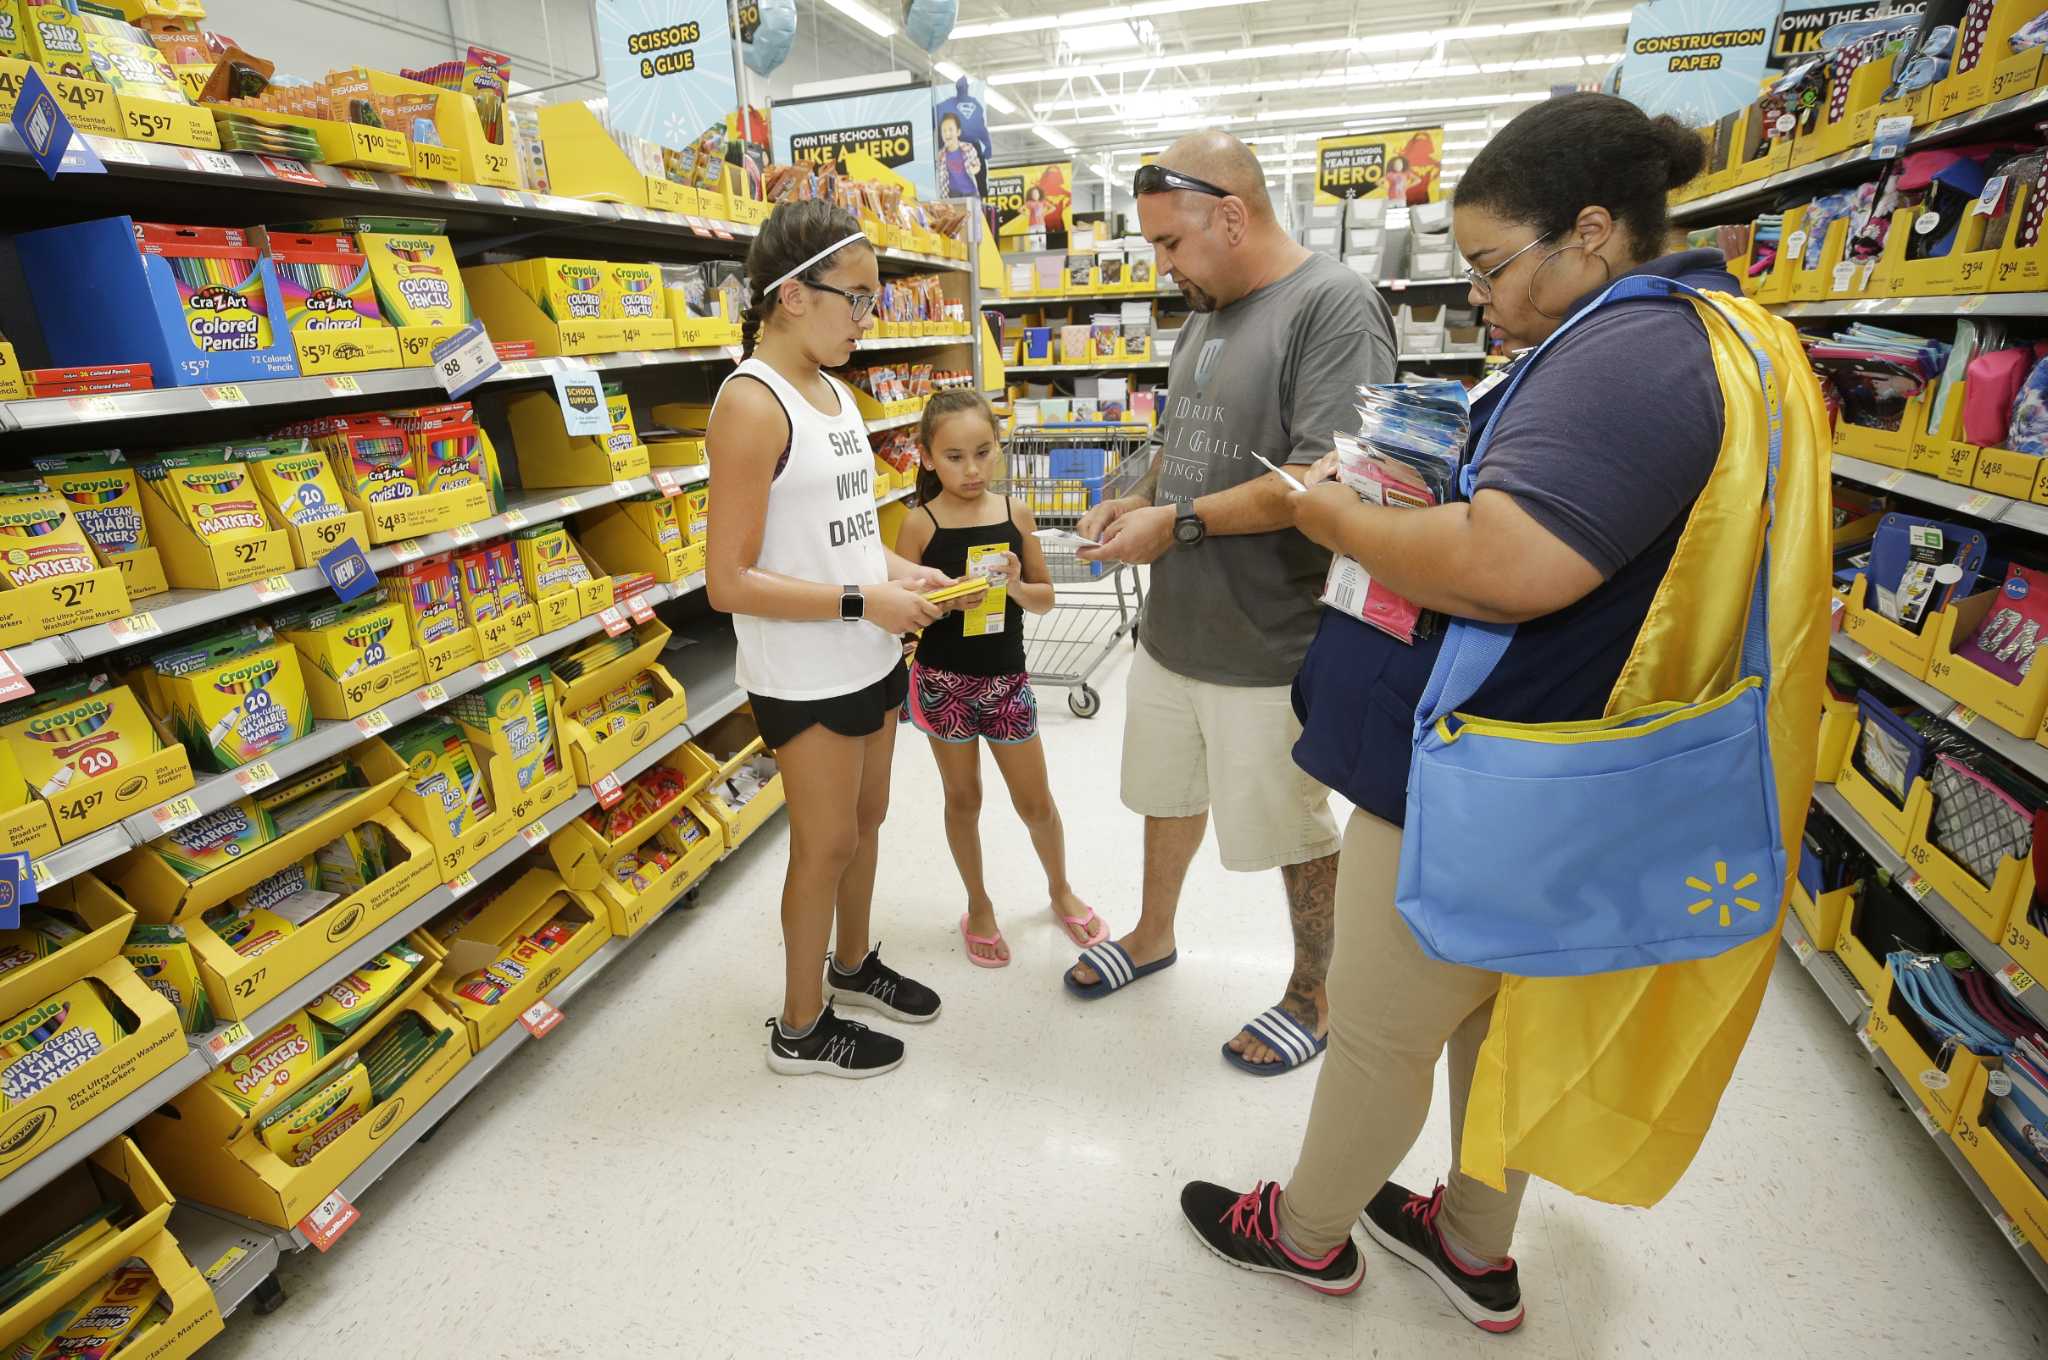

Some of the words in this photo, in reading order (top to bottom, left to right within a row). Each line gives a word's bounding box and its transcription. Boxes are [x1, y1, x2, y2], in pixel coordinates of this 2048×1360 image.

[1781, 12, 1825, 31] OWN
[1829, 9, 1861, 25] THE
[39, 22, 78, 41] Silly
[151, 34, 198, 42] FISKARS
[629, 22, 699, 53] SCISSORS
[1634, 29, 1764, 54] CONSTRUCTION
[1776, 31, 1824, 55] LIK
[109, 54, 154, 74] Silly
[641, 61, 653, 78] &
[656, 52, 693, 75] GLUE
[1669, 54, 1721, 73] PAPER
[331, 84, 368, 96] FISKARS
[398, 104, 433, 113] FISKARS
[794, 135, 818, 147] OWN
[819, 132, 838, 145] THE
[840, 129, 880, 142] SCHOOL
[882, 125, 909, 137] YEAR
[839, 145, 850, 161] A
[1355, 147, 1382, 156] SCHOOL
[1324, 157, 1350, 169] YEAR
[1352, 155, 1371, 166] LIKE
[1373, 154, 1382, 164] A
[1323, 164, 1382, 186] HERO
[359, 223, 371, 232] 50
[389, 239, 431, 250] Crayola
[562, 265, 597, 278] Crayola
[616, 268, 649, 280] Crayola
[400, 279, 448, 295] COLORED
[407, 294, 452, 309] PENCILS
[567, 294, 600, 306] COLORED
[622, 295, 652, 307] COLORED
[571, 305, 600, 318] PENCILS
[624, 305, 653, 318] PENCILS
[191, 317, 257, 335] Colored
[306, 316, 361, 331] Colored
[203, 335, 257, 351] Pencils
[262, 354, 292, 364] Colored
[268, 363, 294, 372] Pencils
[567, 388, 595, 396] SCHOOL
[336, 419, 348, 428] 24
[829, 430, 862, 457] SHE
[162, 459, 174, 467] 10
[276, 459, 319, 472] Crayola
[1162, 460, 1208, 482] HINGS
[62, 476, 123, 493] Crayola
[187, 471, 240, 484] Crayola
[837, 469, 868, 501] WHO
[300, 489, 321, 505] 20
[370, 485, 396, 502] Twist
[397, 484, 412, 498] Up
[75, 507, 133, 522] LTRA-CLEAN
[200, 514, 263, 535] MARKERS
[10, 557, 94, 586] MARKERS
[334, 560, 355, 584] NEW
[57, 608, 94, 620] Ultra-Clean
[95, 608, 120, 618] Markers
[310, 618, 322, 628] 20
[347, 616, 389, 638] Crayola
[367, 647, 382, 663] 20
[172, 663, 188, 676] 20
[218, 658, 275, 685] Crayola
[246, 692, 268, 712] 20
[30, 701, 106, 733] Crayola
[238, 712, 288, 737] WASHABLE
[248, 722, 285, 745] MARKERS
[515, 733, 536, 750] Tips
[81, 752, 112, 775] 20
[157, 770, 173, 780] Broad
[174, 765, 187, 774] Line
[158, 774, 182, 785] Markers
[10, 829, 31, 841] Broad
[32, 823, 47, 832] Line
[13, 833, 41, 848] Markers
[189, 820, 247, 851] MARKERS
[226, 845, 239, 855] 10
[248, 867, 304, 905] WASHABLE
[259, 881, 303, 909] MARKERS
[3, 1027, 82, 1080] ULTRA-CLEAN
[1, 1032, 100, 1098] WASHABLE
[235, 1037, 308, 1093] MARKERS
[68, 1088, 86, 1103] 10ct
[87, 1056, 137, 1090] Ultra-Clean
[276, 1071, 289, 1083] 10
[70, 1088, 100, 1111] Classic
[102, 1067, 136, 1091] Markers
[294, 1087, 347, 1128] Crayola
[262, 1117, 274, 1128] 10
[0, 1114, 43, 1151] Crayola
[325, 1210, 354, 1238] Rollback
[177, 1308, 214, 1339] Markers
